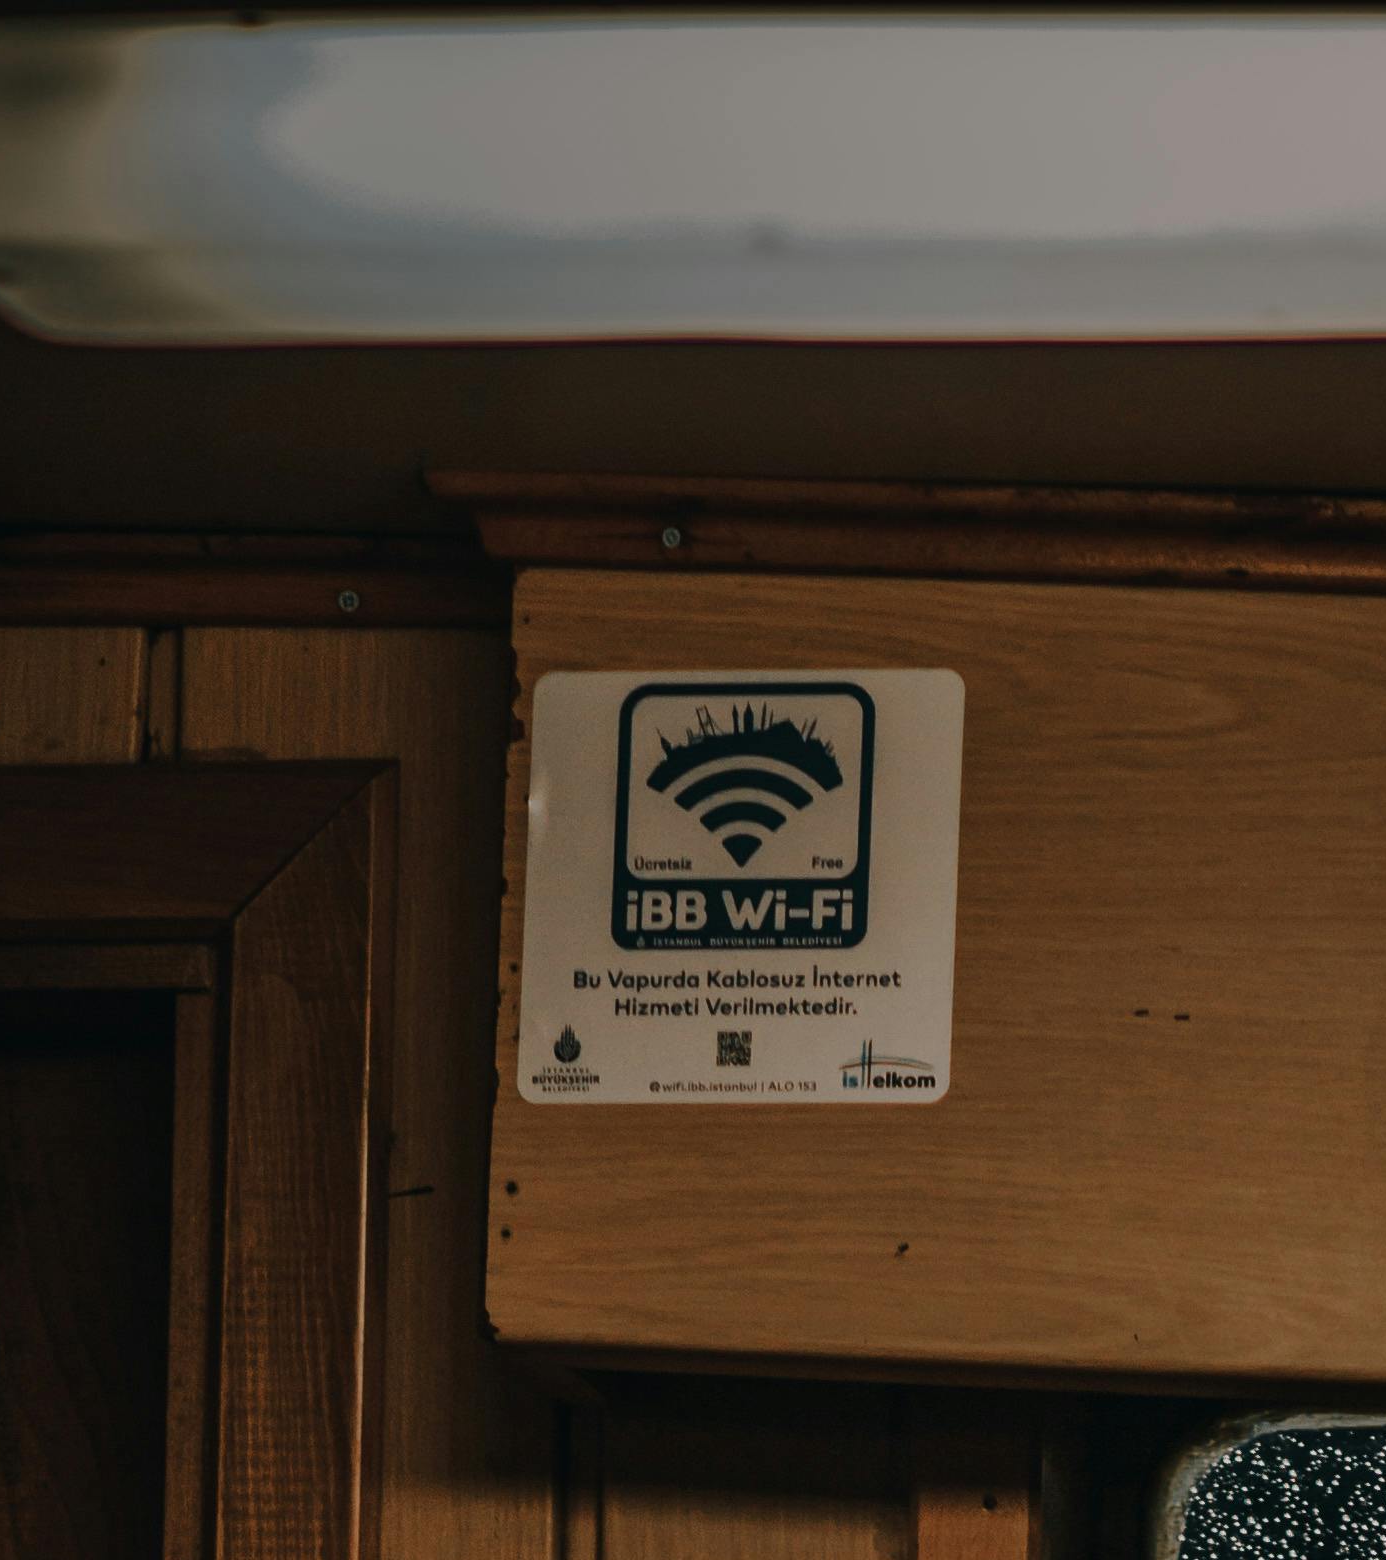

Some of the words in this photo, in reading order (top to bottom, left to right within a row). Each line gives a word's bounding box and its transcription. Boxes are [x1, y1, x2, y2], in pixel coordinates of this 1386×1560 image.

[634, 856, 693, 871] Ücretsiz
[812, 856, 843, 870] Free
[626, 889, 708, 931] iBB
[722, 889, 854, 931] Wi-Fi
[573, 970, 601, 989] Bu
[607, 969, 700, 993] Vapurda
[706, 968, 806, 989] Kablosuz
[813, 965, 902, 988] İnternet
[614, 997, 699, 1016] Hizmeti
[706, 996, 858, 1016] Verilmektedir.
[768, 1082, 795, 1092] ALO
